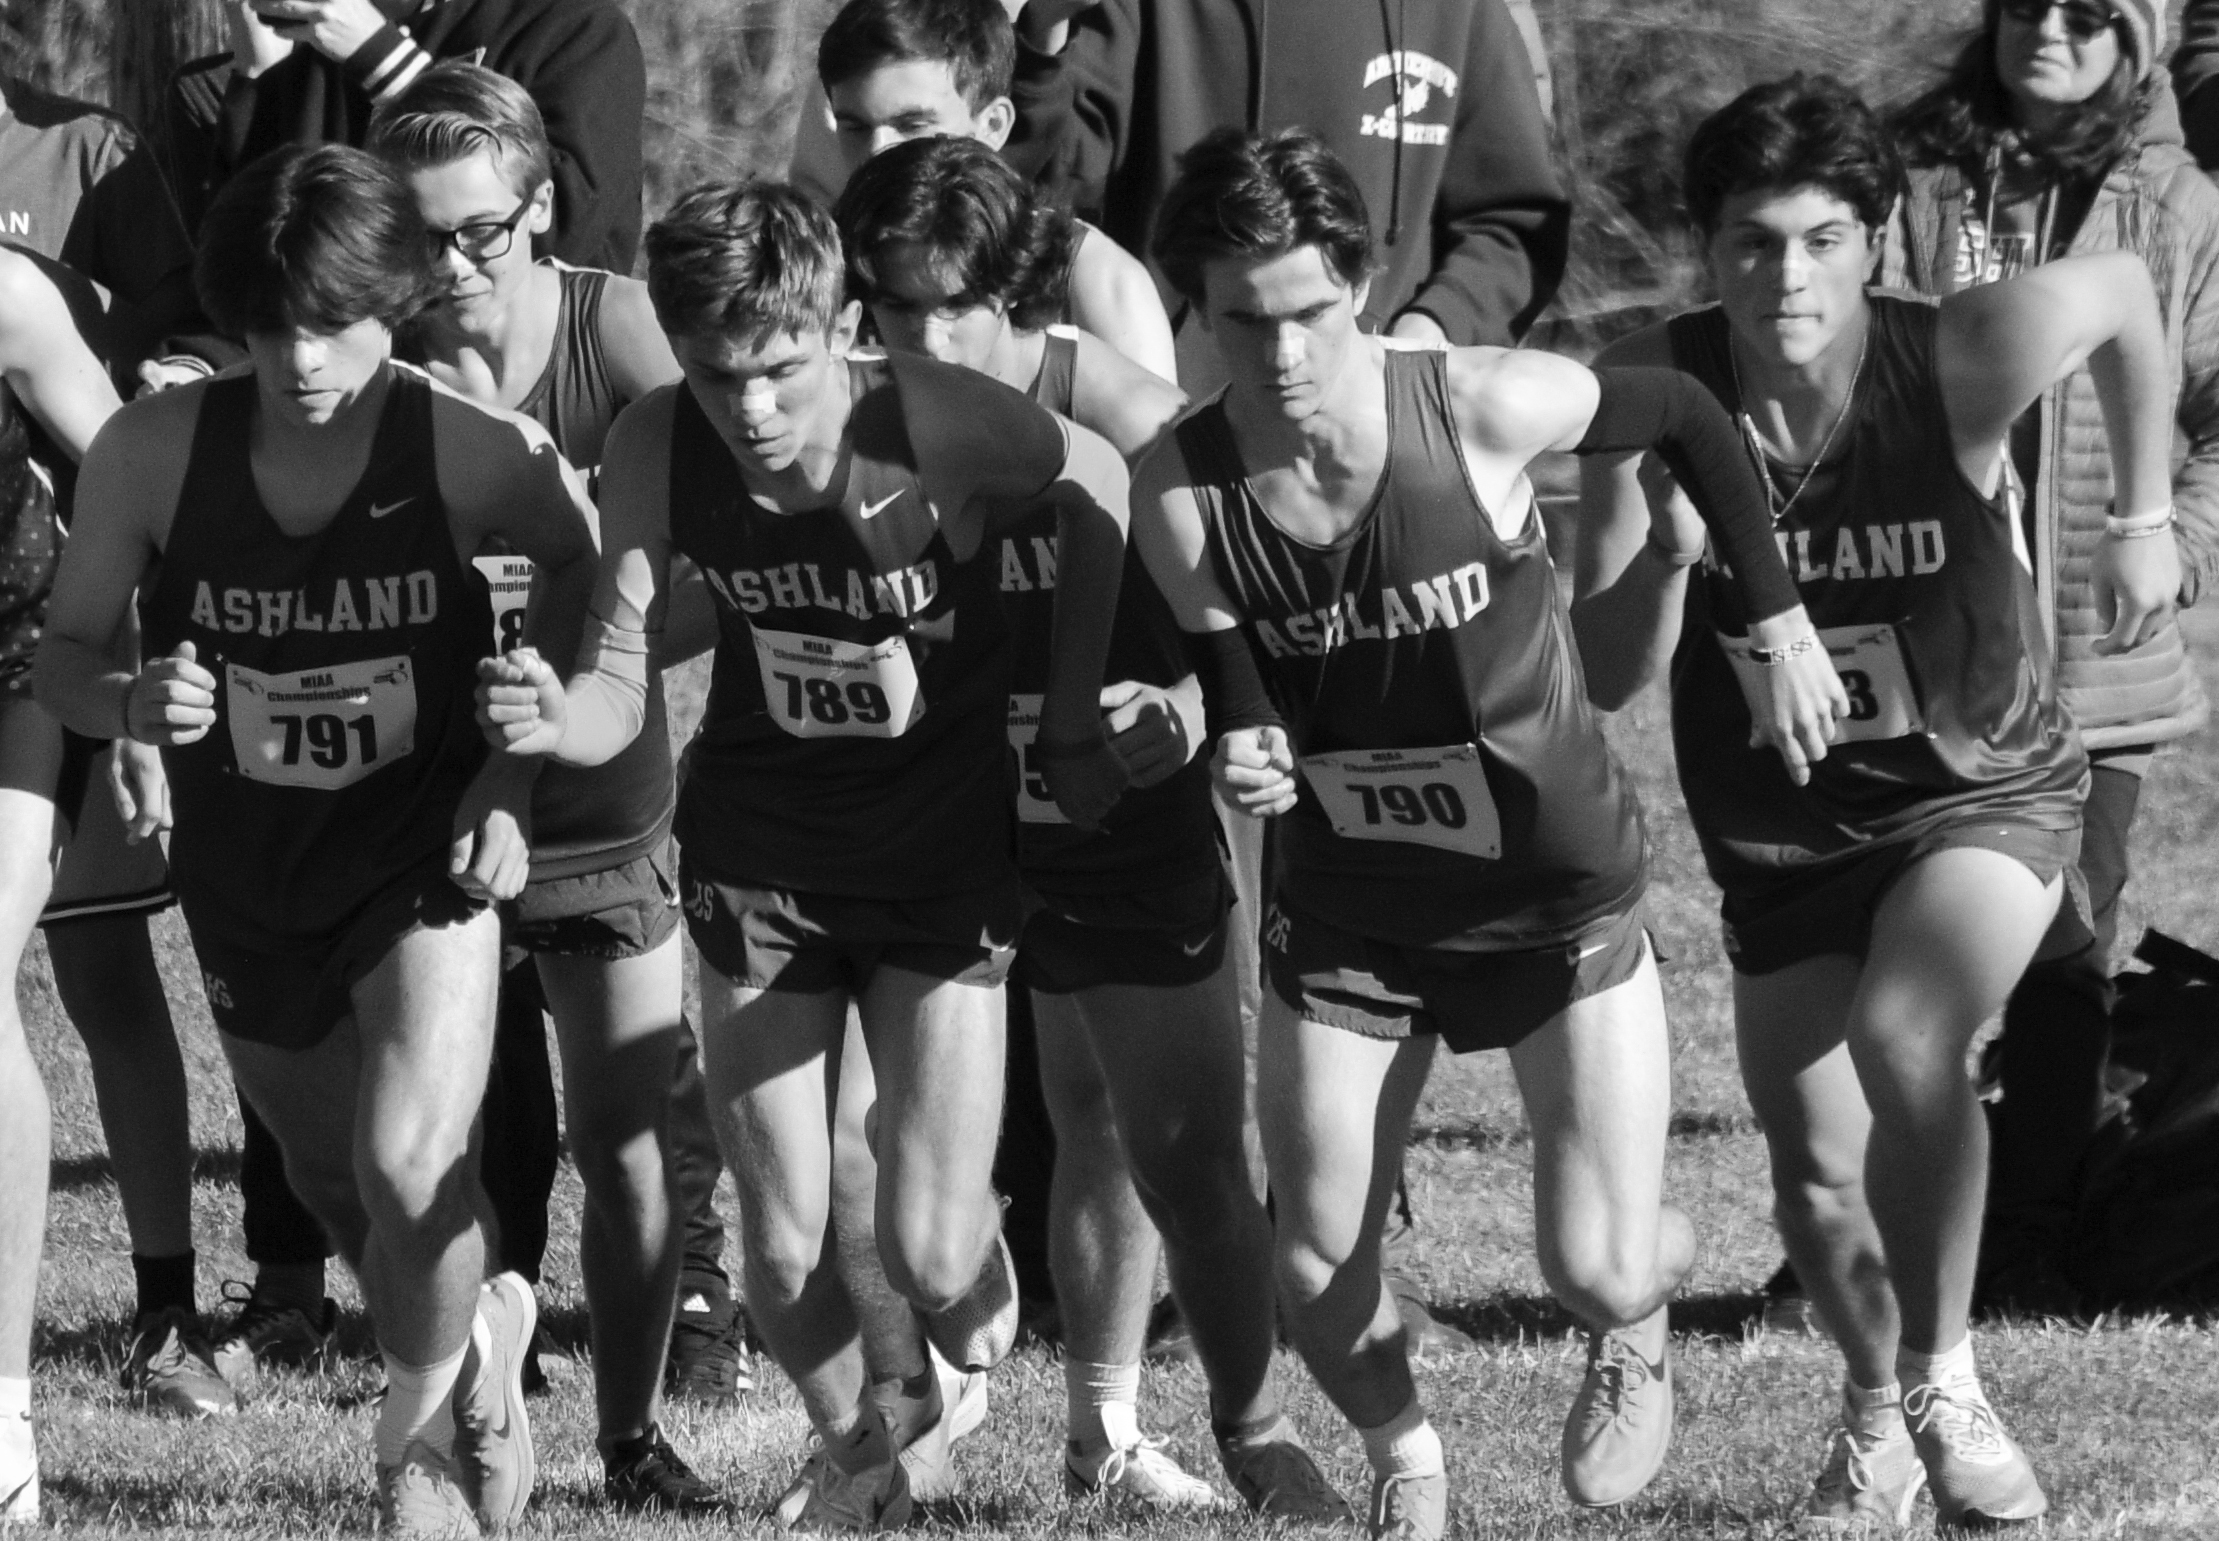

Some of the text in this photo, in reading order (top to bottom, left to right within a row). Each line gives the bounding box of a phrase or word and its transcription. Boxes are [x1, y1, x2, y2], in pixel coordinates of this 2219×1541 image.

[191, 569, 438, 637] ASHLAND
[706, 559, 938, 620] ASHLAND
[1256, 561, 1490, 658] ASHLAND
[301, 673, 334, 689] MIAA
[773, 671, 892, 724] 789
[270, 713, 377, 769] 791
[1345, 782, 1467, 830] 790
